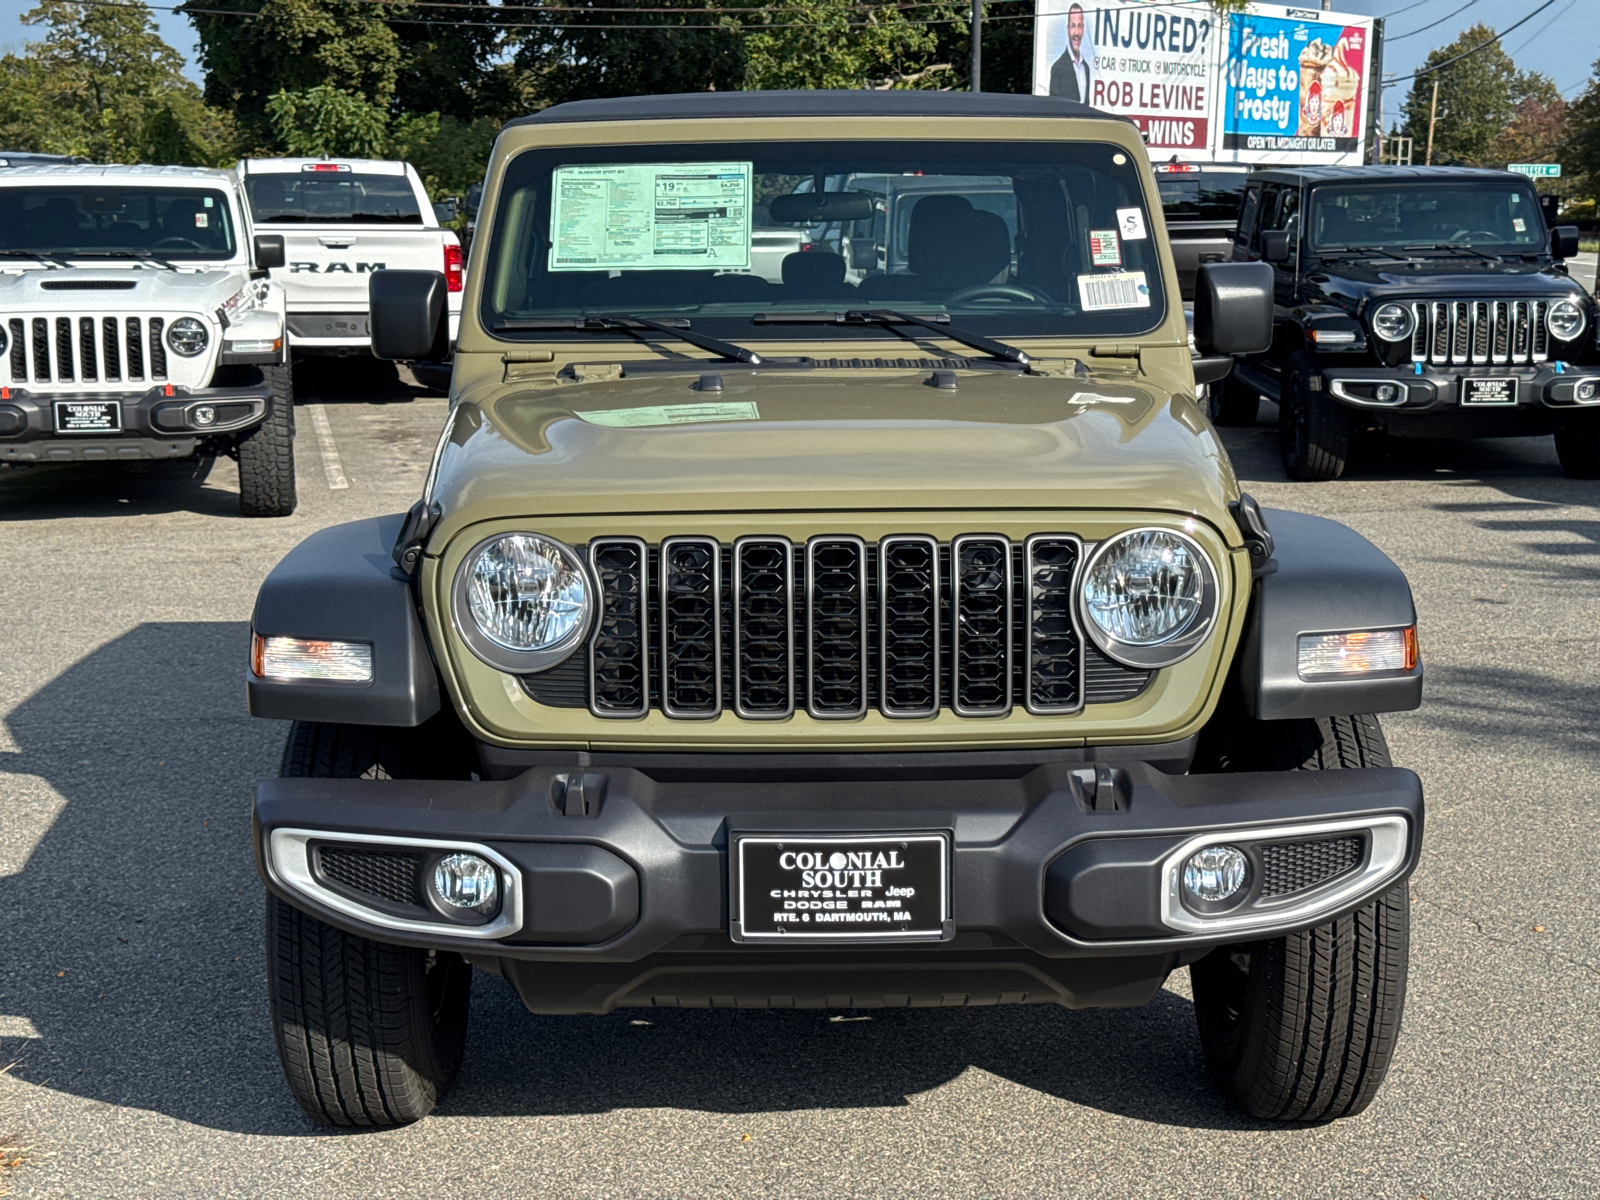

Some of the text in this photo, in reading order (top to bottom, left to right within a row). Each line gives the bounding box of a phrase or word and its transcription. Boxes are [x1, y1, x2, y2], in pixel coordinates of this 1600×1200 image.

[1094, 7, 1210, 55] INJURED?
[1241, 27, 1289, 60] Fresh
[1101, 56, 1206, 77] CAR TRUCK MOTORCYCLE
[1229, 57, 1297, 97] Ways to
[1094, 80, 1205, 111] ROB LEVINE
[1234, 91, 1291, 129] Frosty
[1133, 119, 1195, 146] -WINS
[1247, 136, 1265, 149] OPEN
[1277, 136, 1307, 149] MIDNIGHT
[1308, 137, 1316, 150] OR
[1317, 138, 1336, 150] LATER
[662, 182, 675, 191] 19
[289, 261, 386, 274] RAM
[779, 851, 904, 870] COLONIAL
[802, 869, 883, 888] SOUTH
[770, 885, 915, 898] CHRYSLER Jeep
[783, 900, 902, 909] DODGE RAM
[773, 911, 912, 923] RTE. 6 DARTMOUTH, MA
